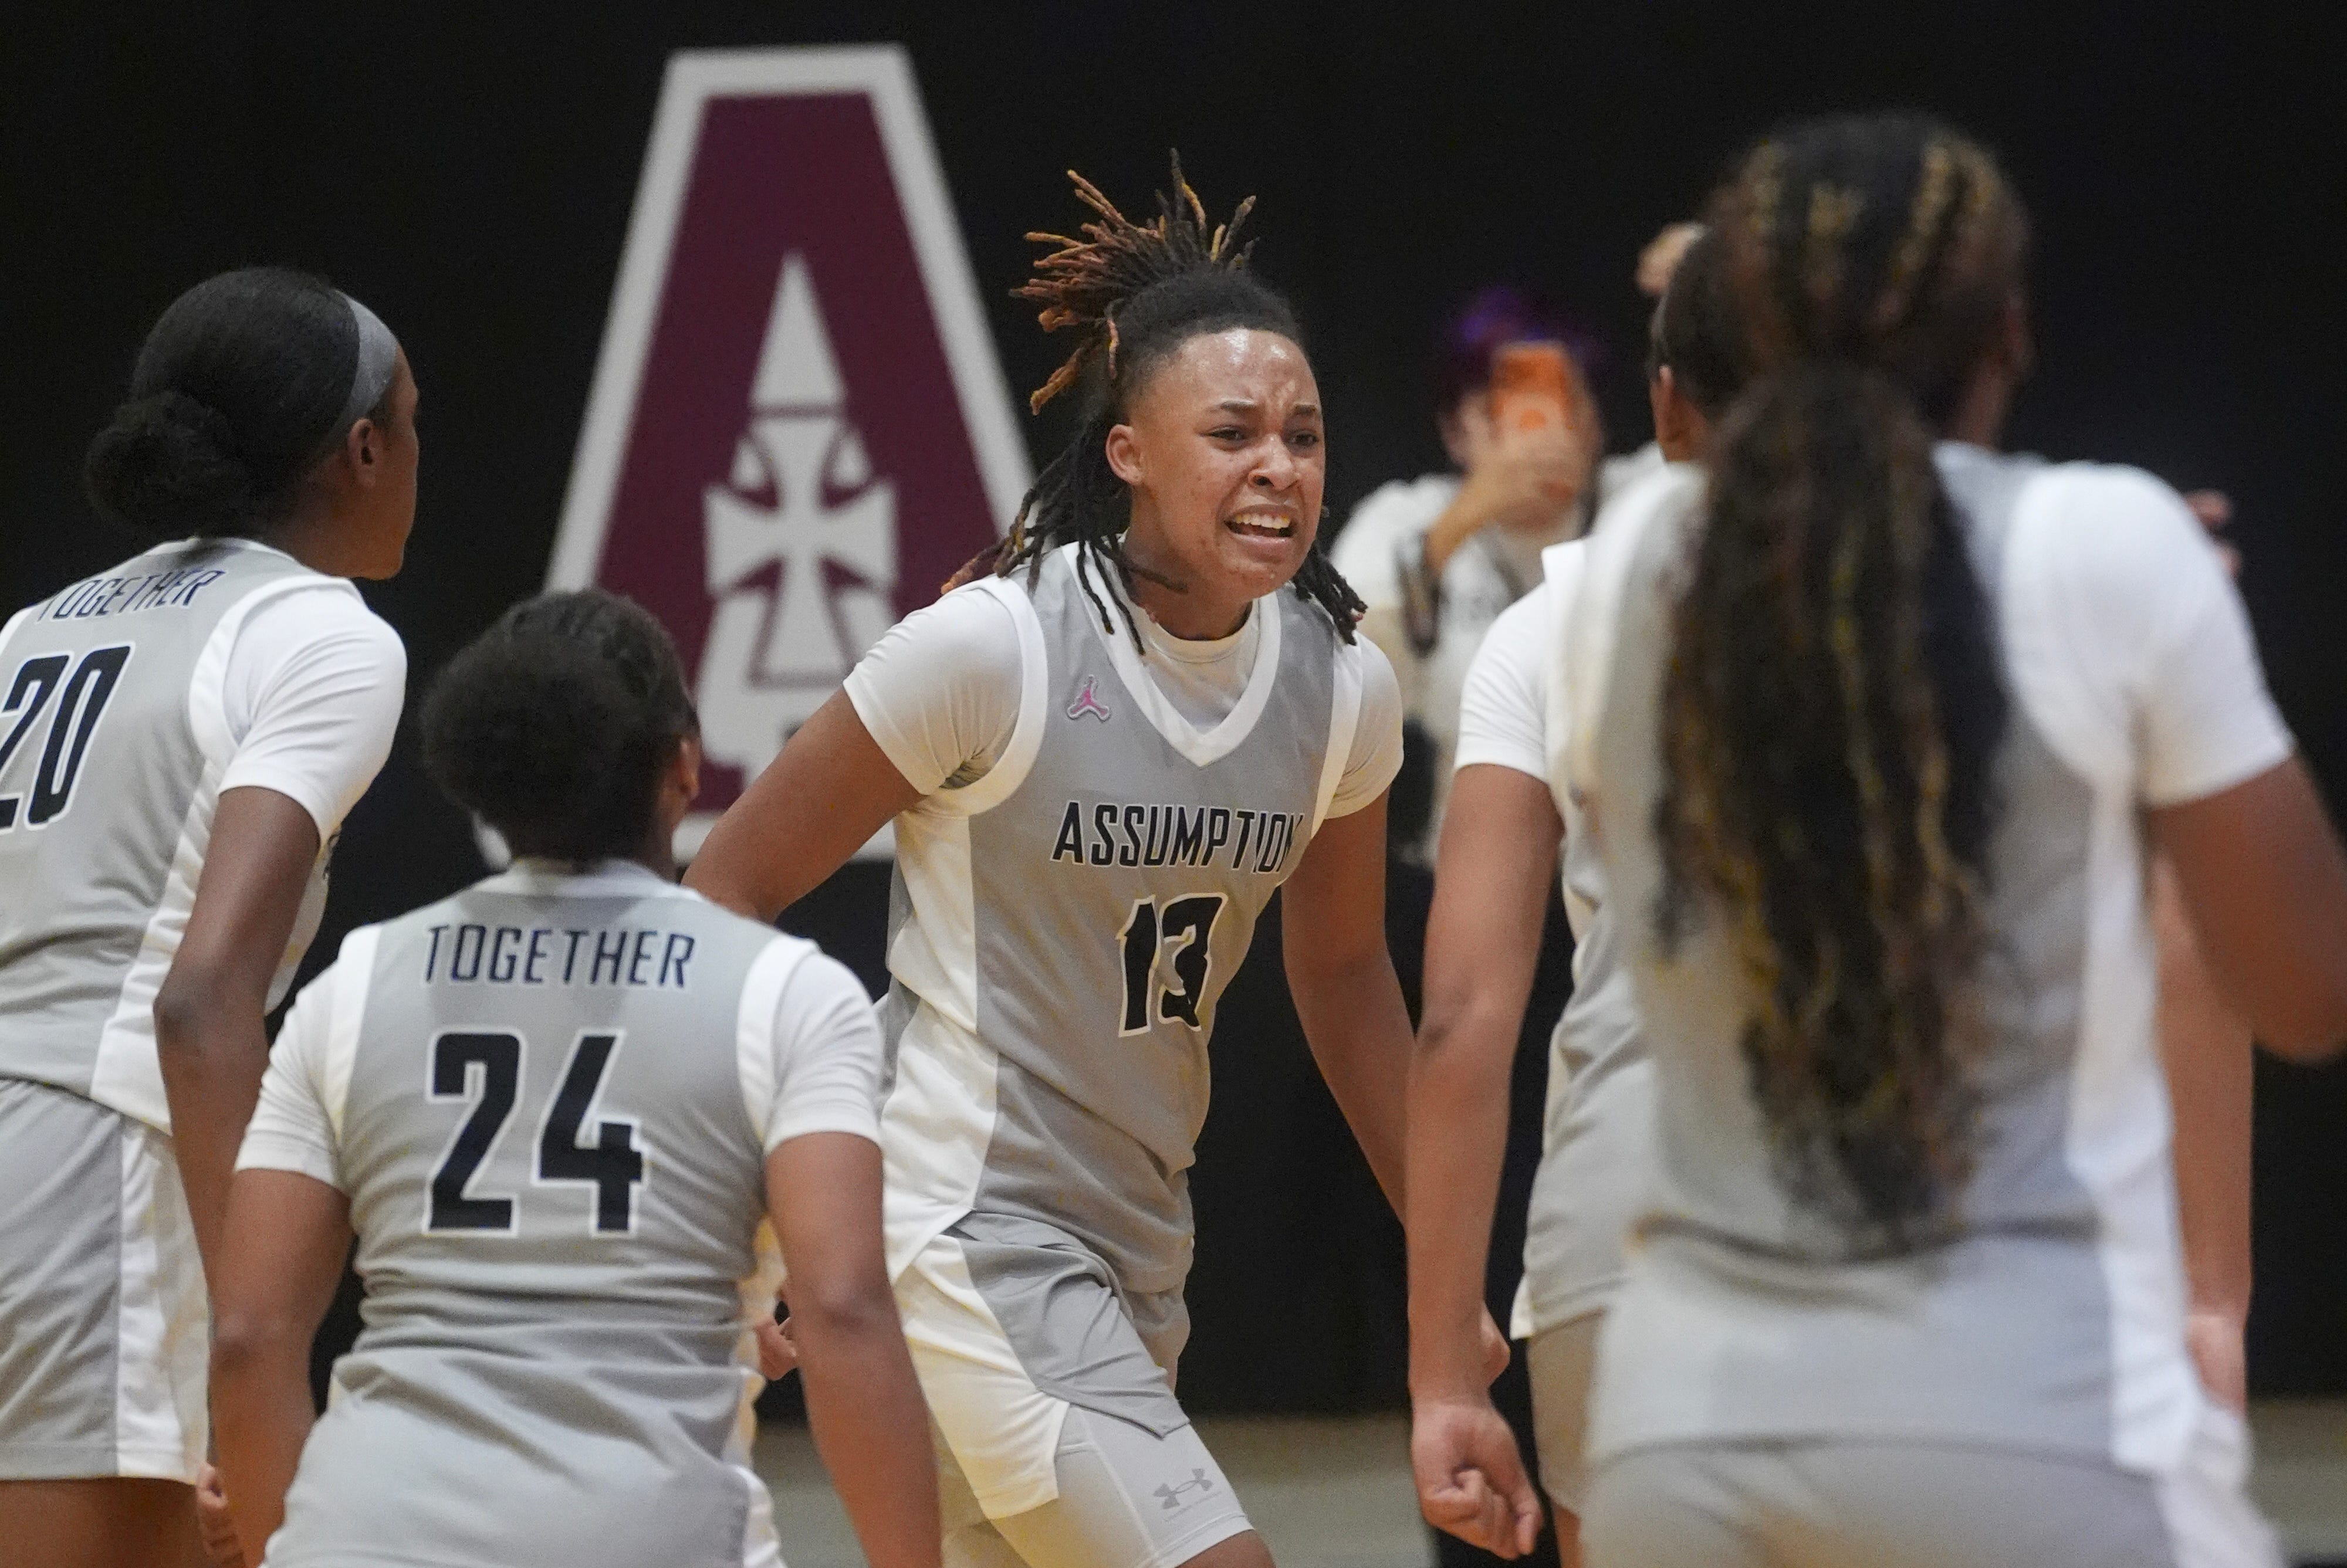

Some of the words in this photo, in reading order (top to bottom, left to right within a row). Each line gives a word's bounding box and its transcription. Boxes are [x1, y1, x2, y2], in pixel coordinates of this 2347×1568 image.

[37, 568, 226, 620] TOGETHER
[0, 644, 133, 828] 20
[426, 924, 695, 987] TOGETHER
[1117, 892, 1227, 1036] 13
[425, 1028, 646, 1234] 24
